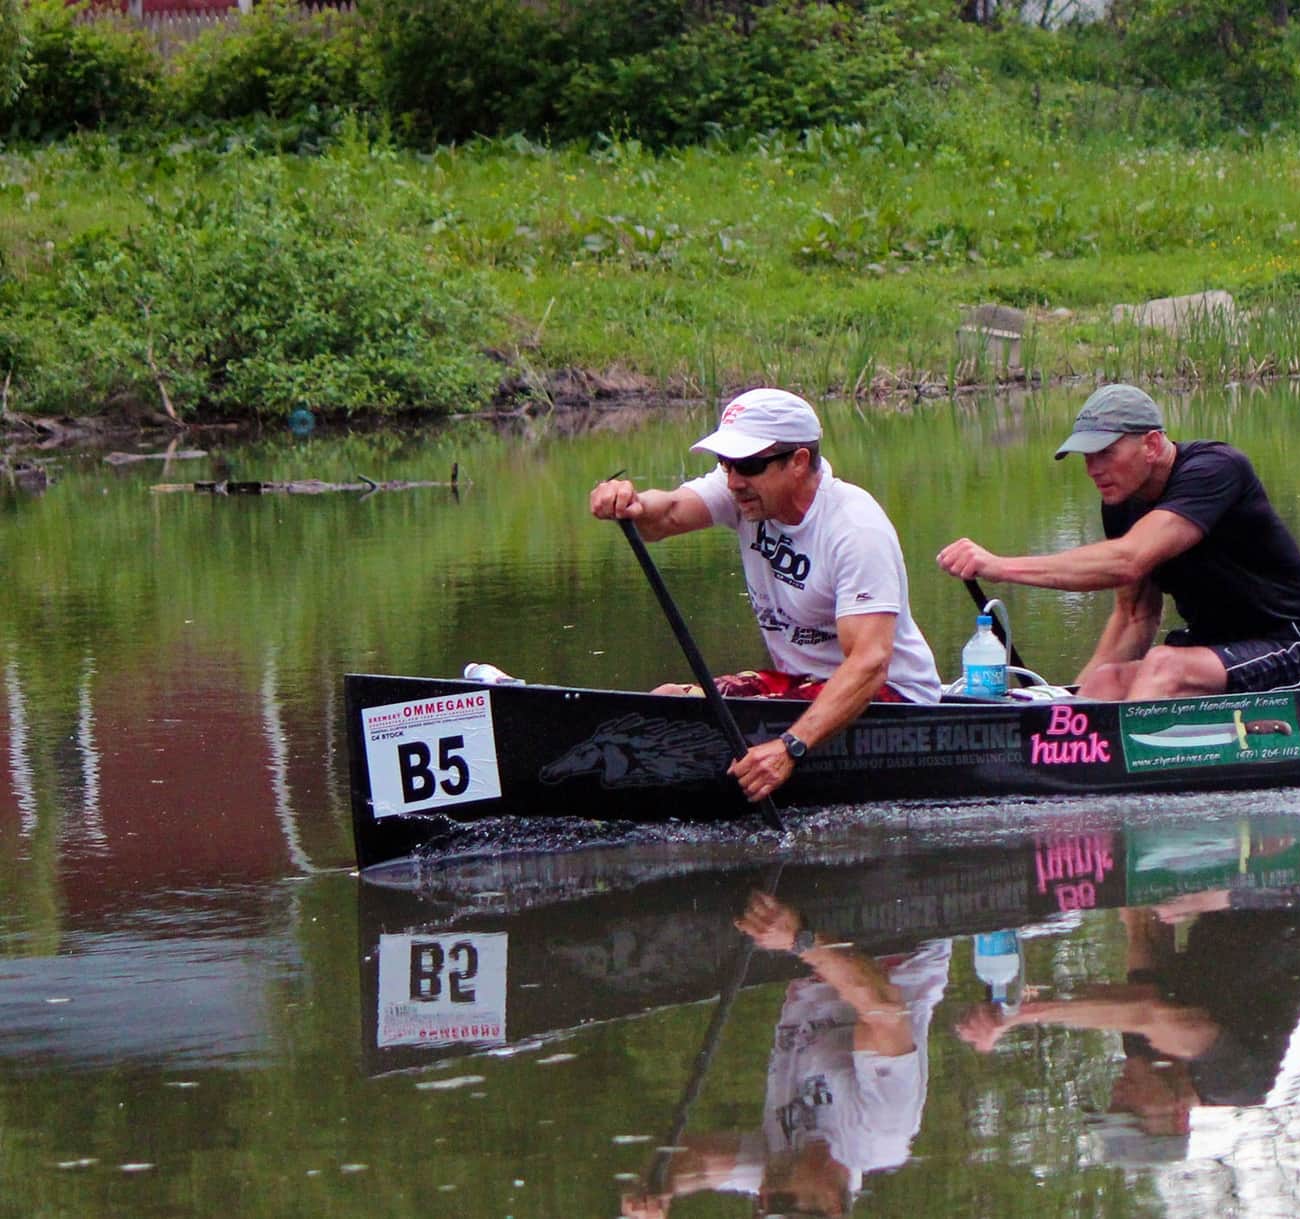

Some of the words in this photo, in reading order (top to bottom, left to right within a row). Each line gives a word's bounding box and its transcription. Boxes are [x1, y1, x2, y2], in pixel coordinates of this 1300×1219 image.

[403, 696, 485, 717] OMMEGANG
[1047, 705, 1089, 735] Bo
[1125, 704, 1168, 718] Stephen
[1171, 703, 1195, 716] Lynn
[1198, 698, 1252, 712] Handmade
[1254, 696, 1289, 708] Knives
[855, 724, 931, 755] HORSE
[936, 721, 1021, 751] RACING
[1031, 733, 1110, 765] hunk
[398, 735, 470, 803] B5
